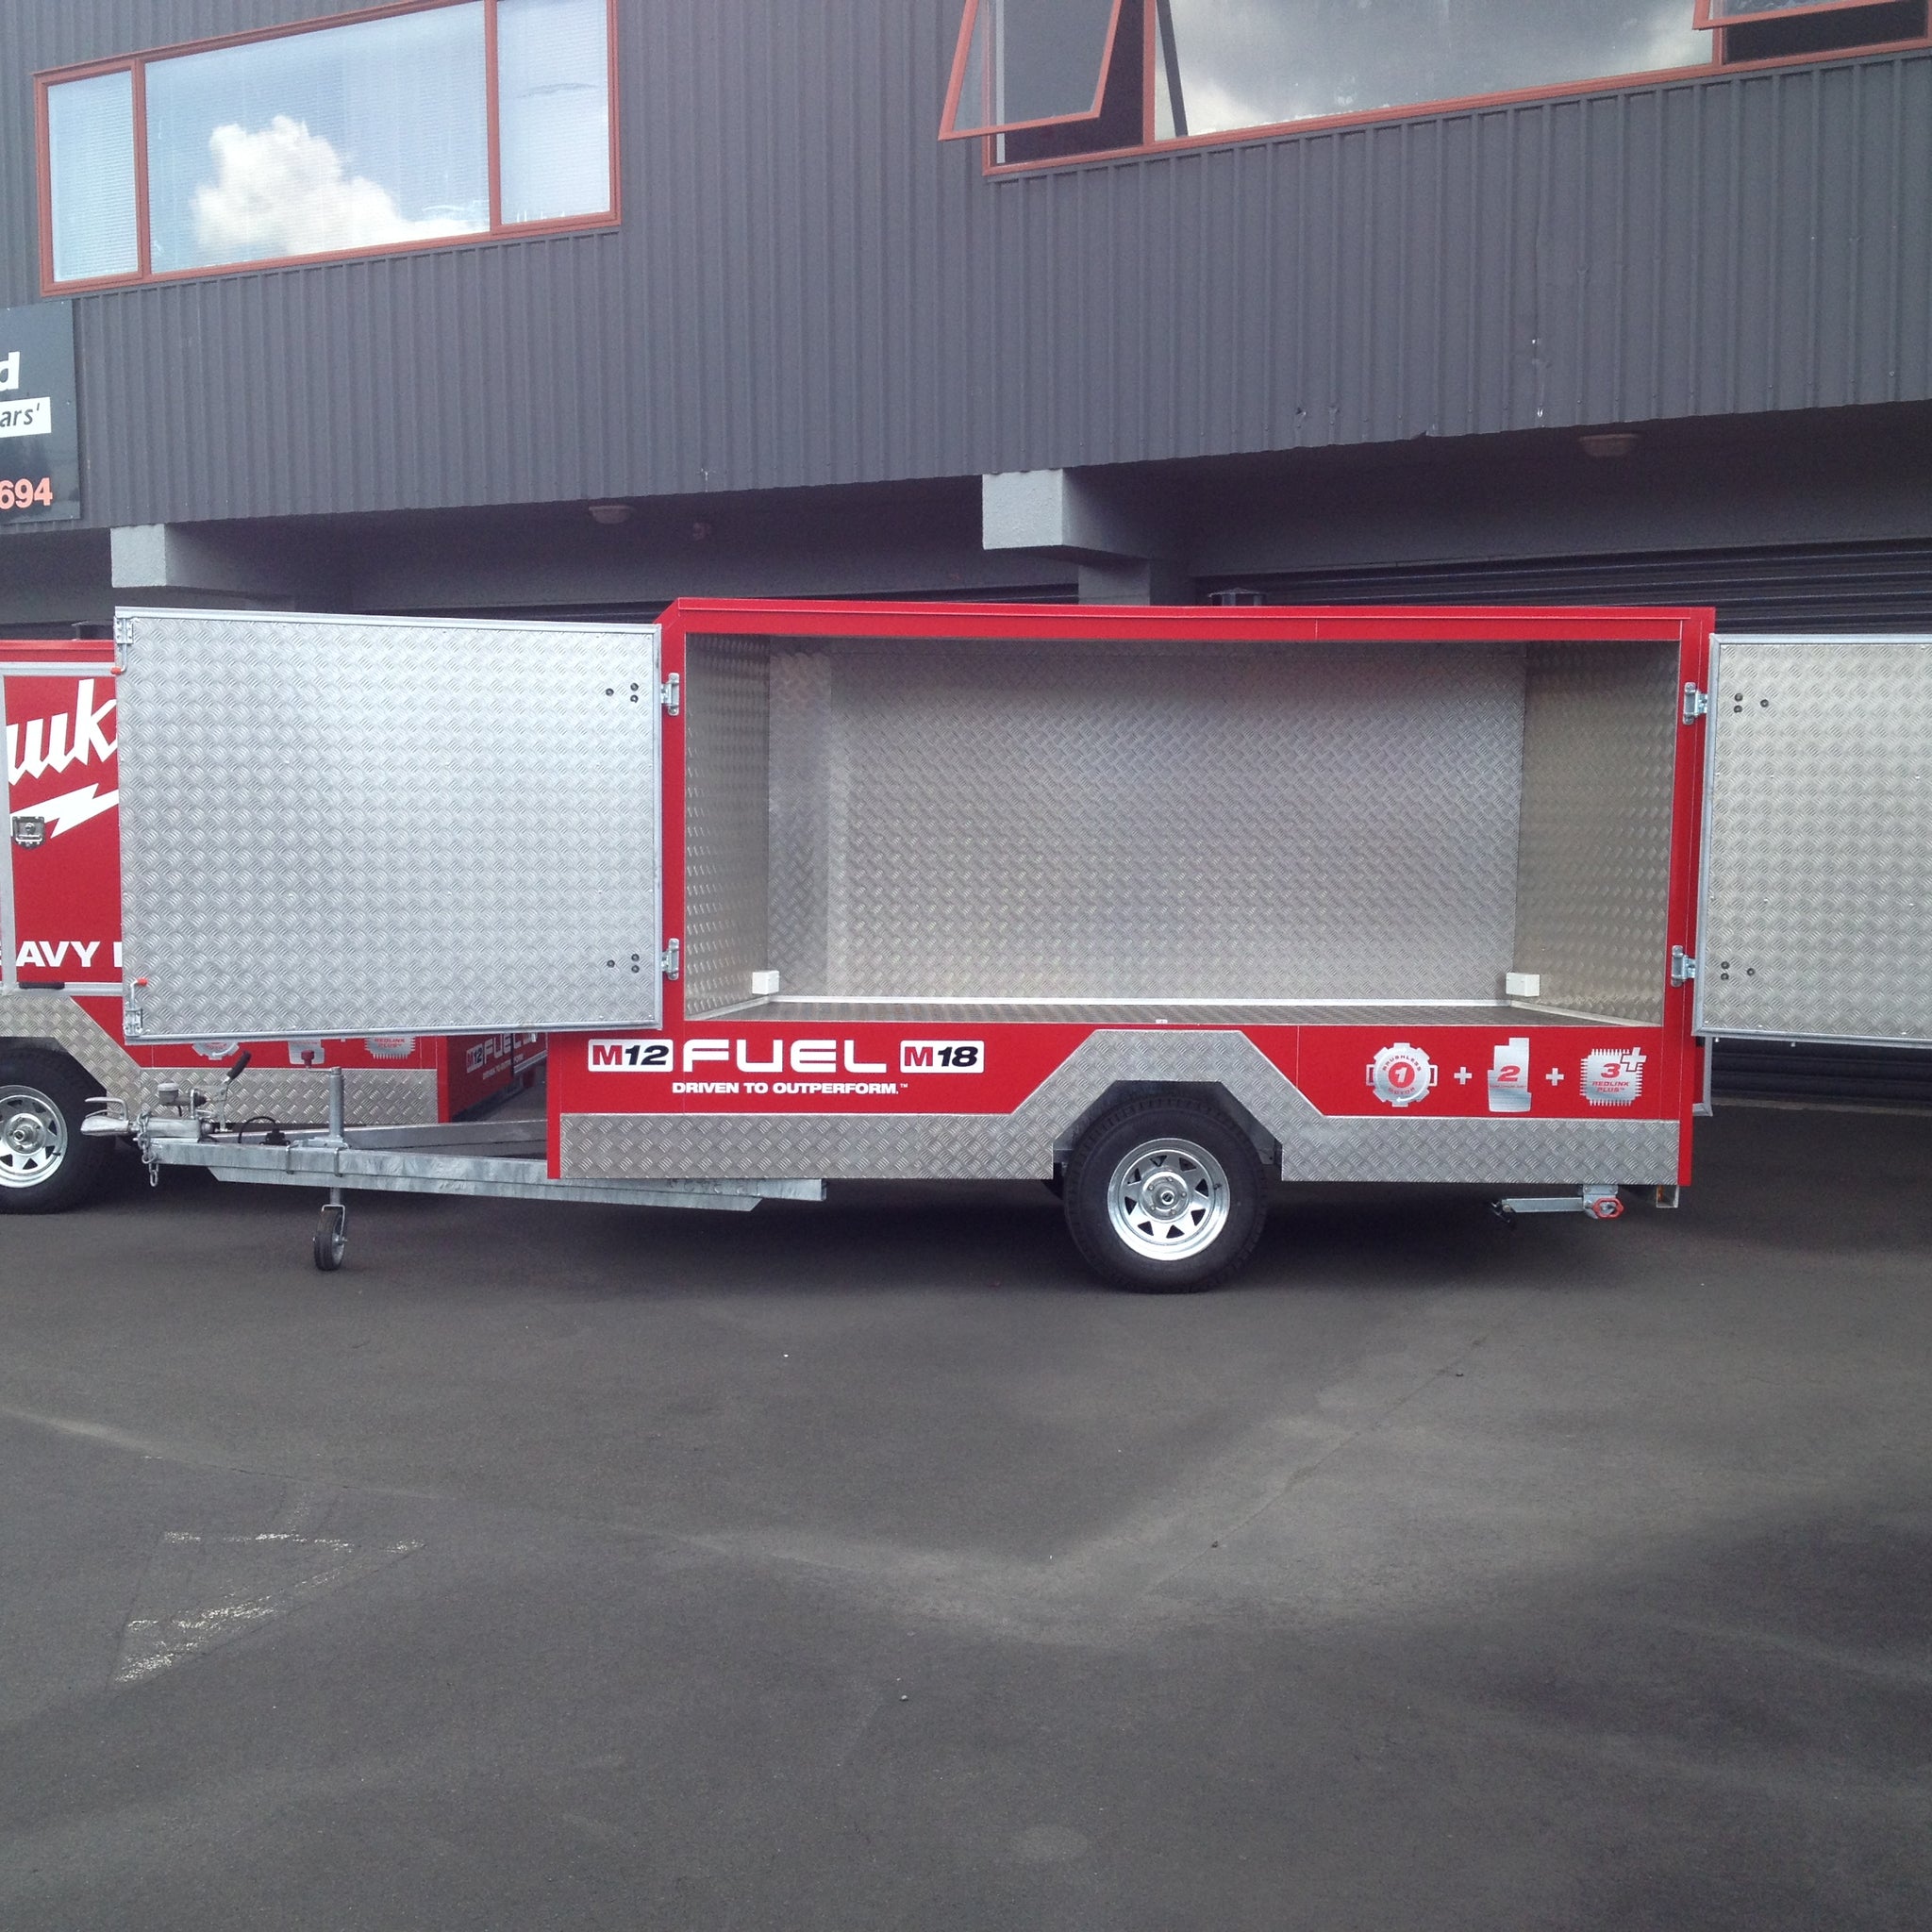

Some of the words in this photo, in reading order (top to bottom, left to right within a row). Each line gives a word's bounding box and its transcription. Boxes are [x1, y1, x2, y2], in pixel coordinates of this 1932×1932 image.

[0, 477, 53, 509] 694
[0, 941, 101, 968] AVY
[592, 1044, 670, 1066] M12
[683, 1039, 887, 1073] FUEL
[904, 1045, 978, 1067] M18
[1395, 1066, 1407, 1083] 1
[1497, 1065, 1521, 1082] 2
[672, 1082, 740, 1094] DRIVEN
[743, 1082, 769, 1094] TO
